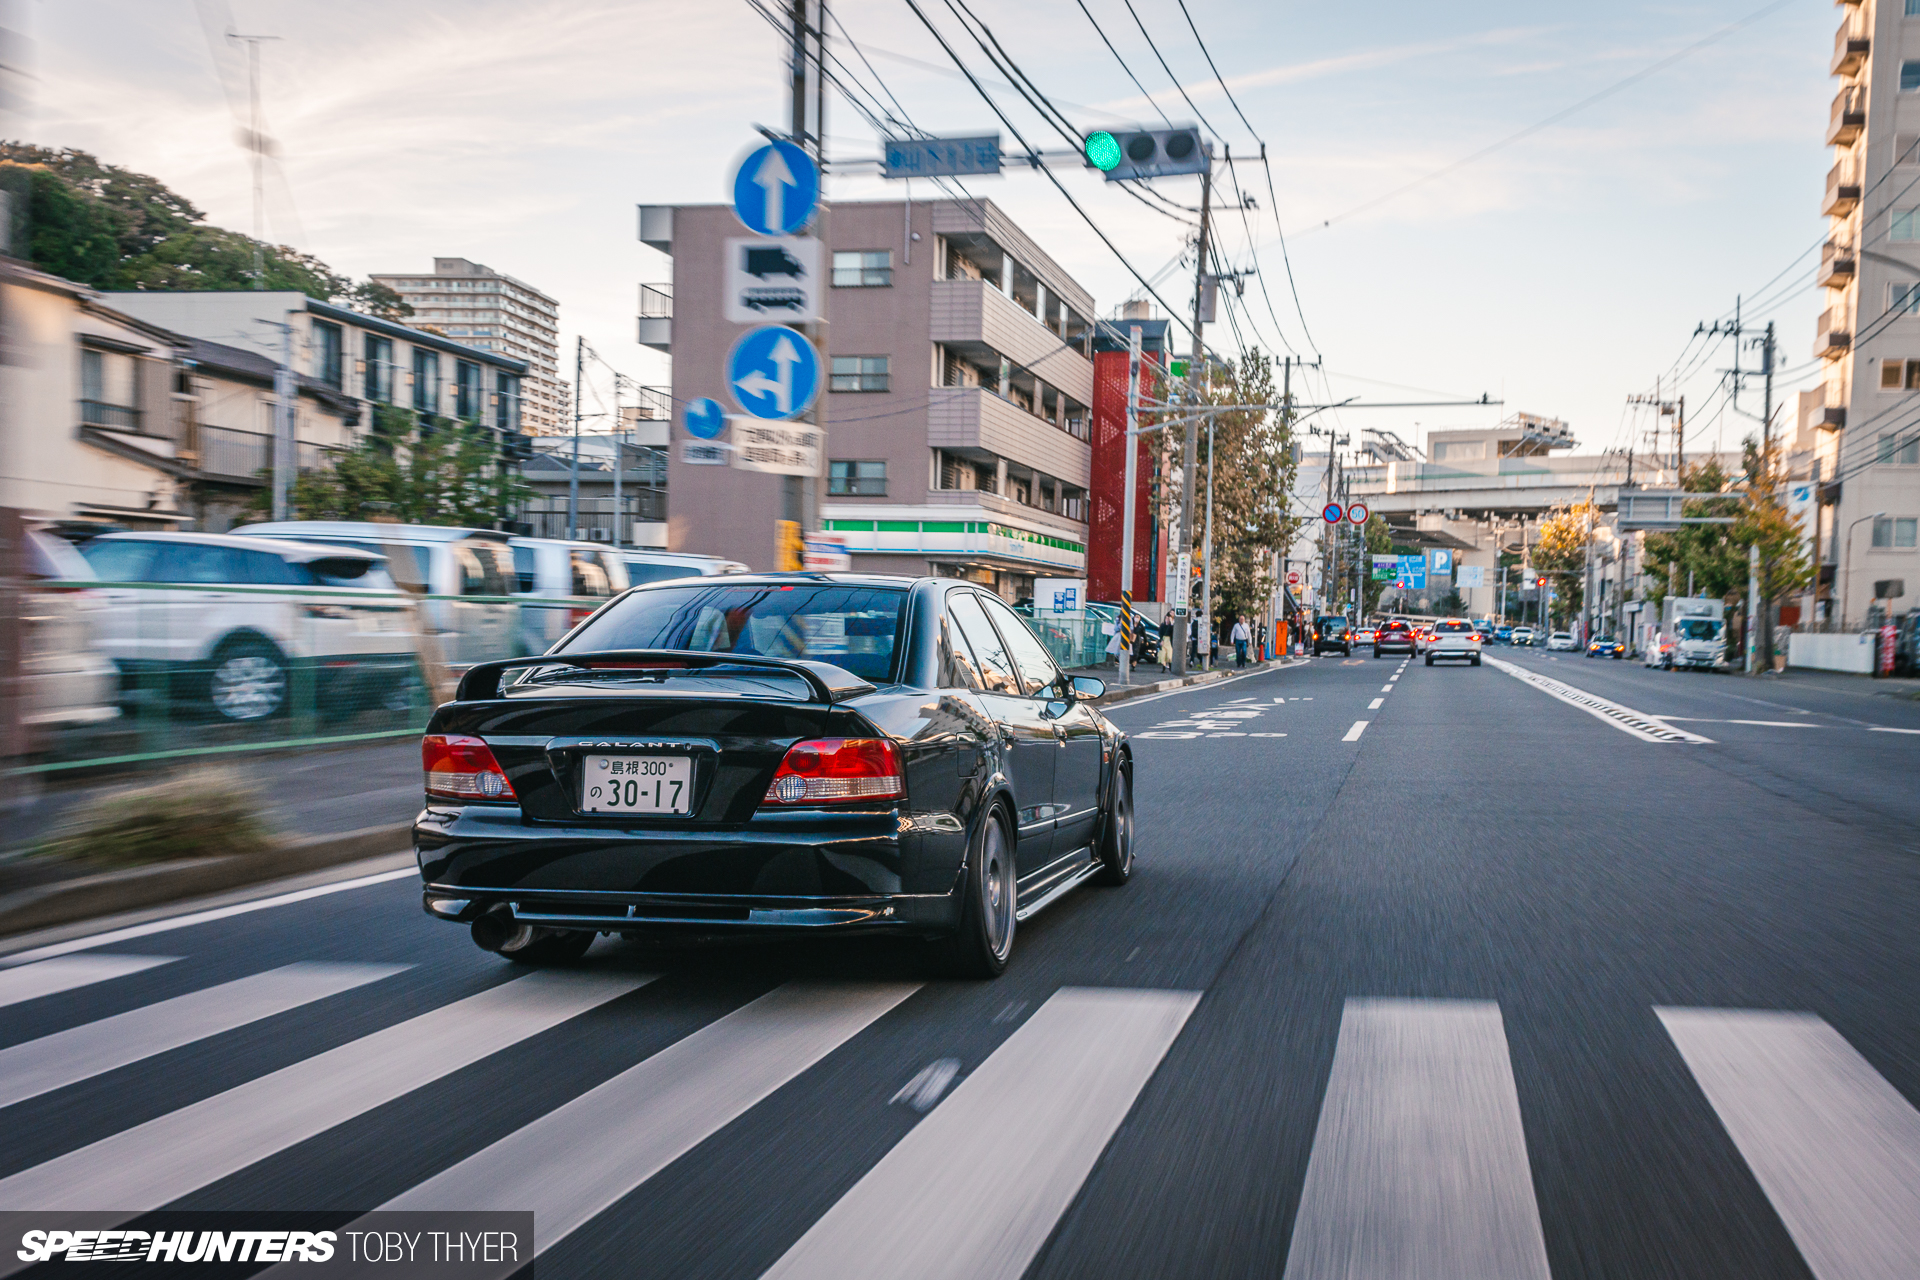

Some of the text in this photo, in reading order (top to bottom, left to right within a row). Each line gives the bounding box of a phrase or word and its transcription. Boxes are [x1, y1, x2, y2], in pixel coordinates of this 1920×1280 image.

[1351, 508, 1365, 520] 50
[1435, 551, 1448, 569] P
[590, 779, 684, 808] の 30-17
